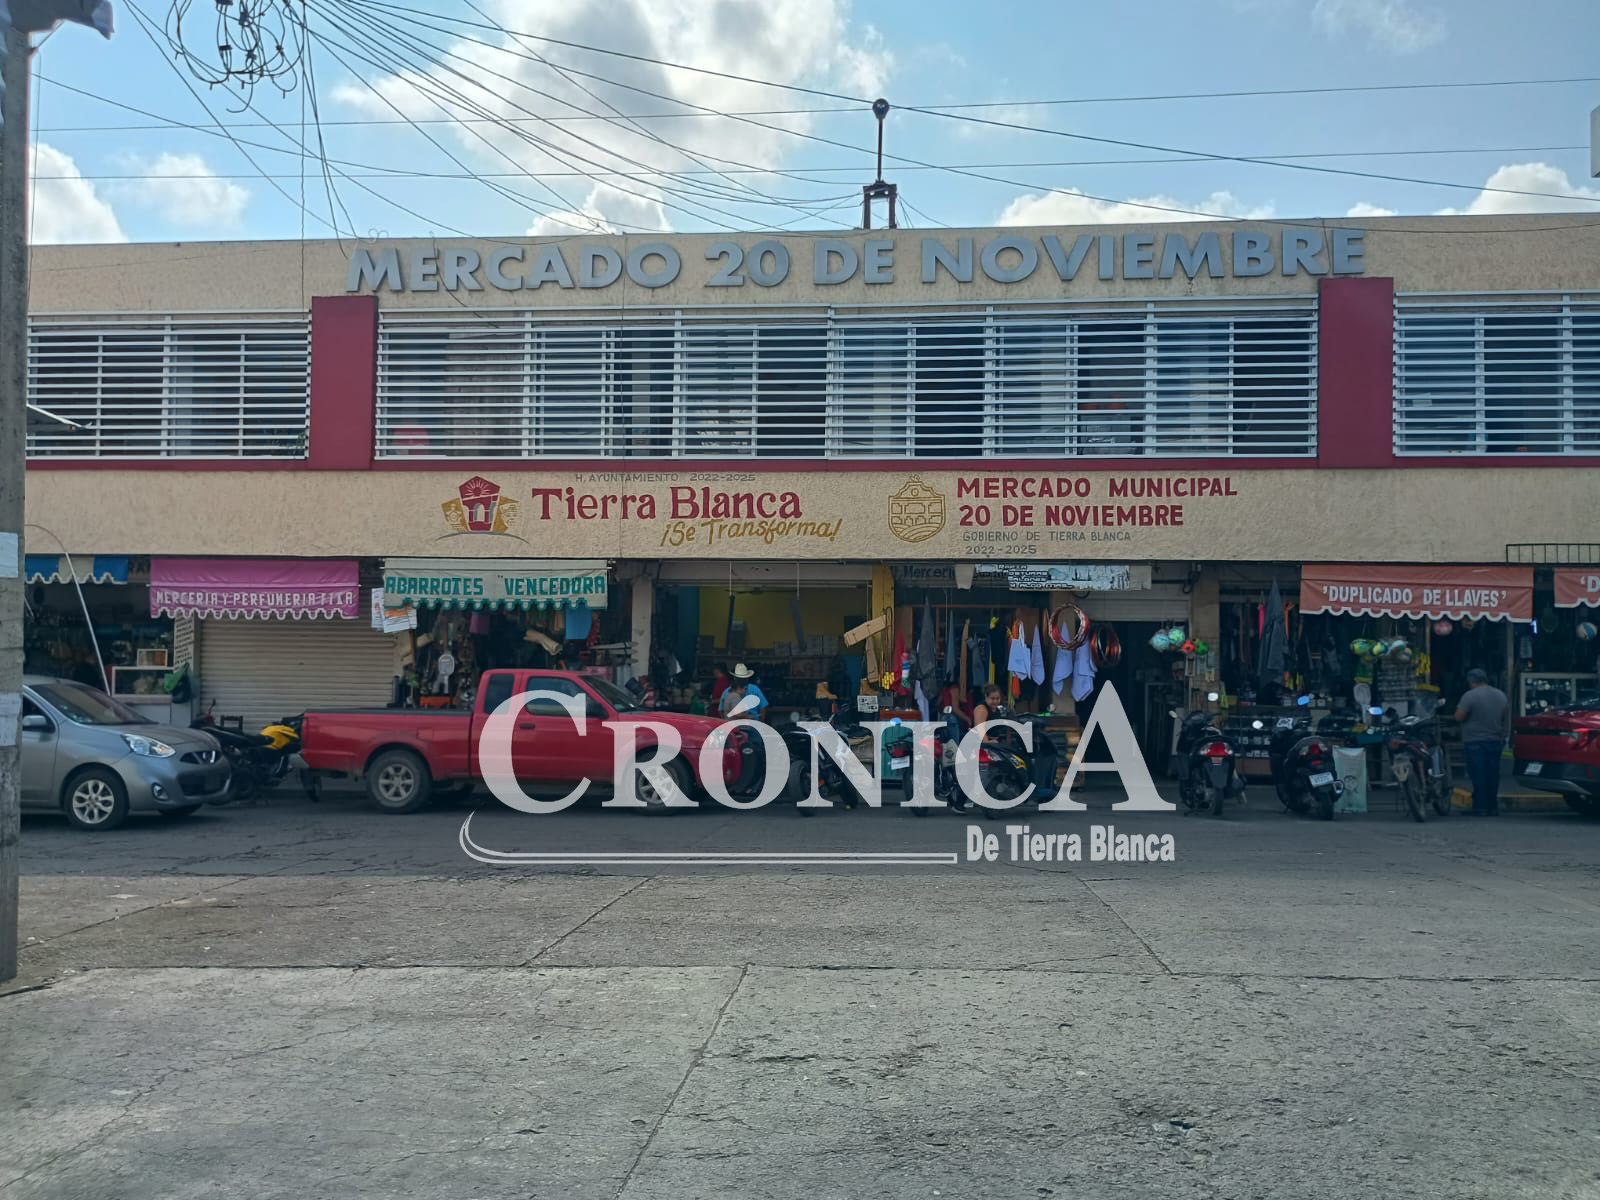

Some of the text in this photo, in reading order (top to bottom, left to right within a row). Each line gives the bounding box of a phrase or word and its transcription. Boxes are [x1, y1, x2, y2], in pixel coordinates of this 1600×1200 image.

[346, 229, 1365, 292] MERCADO 20 DE NOVIEMBRE
[588, 473, 679, 482] AYUNTAMIENTO
[690, 473, 756, 482] 2022-2025
[957, 477, 1238, 498] MERCADO MUNICIPAL
[531, 486, 803, 520] Tierra Blanca
[959, 504, 1184, 526] 20 DE NOVIEMBRE
[702, 518, 843, 545] Transforma!
[963, 531, 1131, 541] GOBIERNO DE TIERRA BLANCA
[385, 575, 484, 596] ABARROTES
[156, 591, 218, 604] MERCERIA
[222, 592, 229, 605] Y
[233, 592, 315, 606] PERFUMERIA
[1423, 589, 1441, 606] DE
